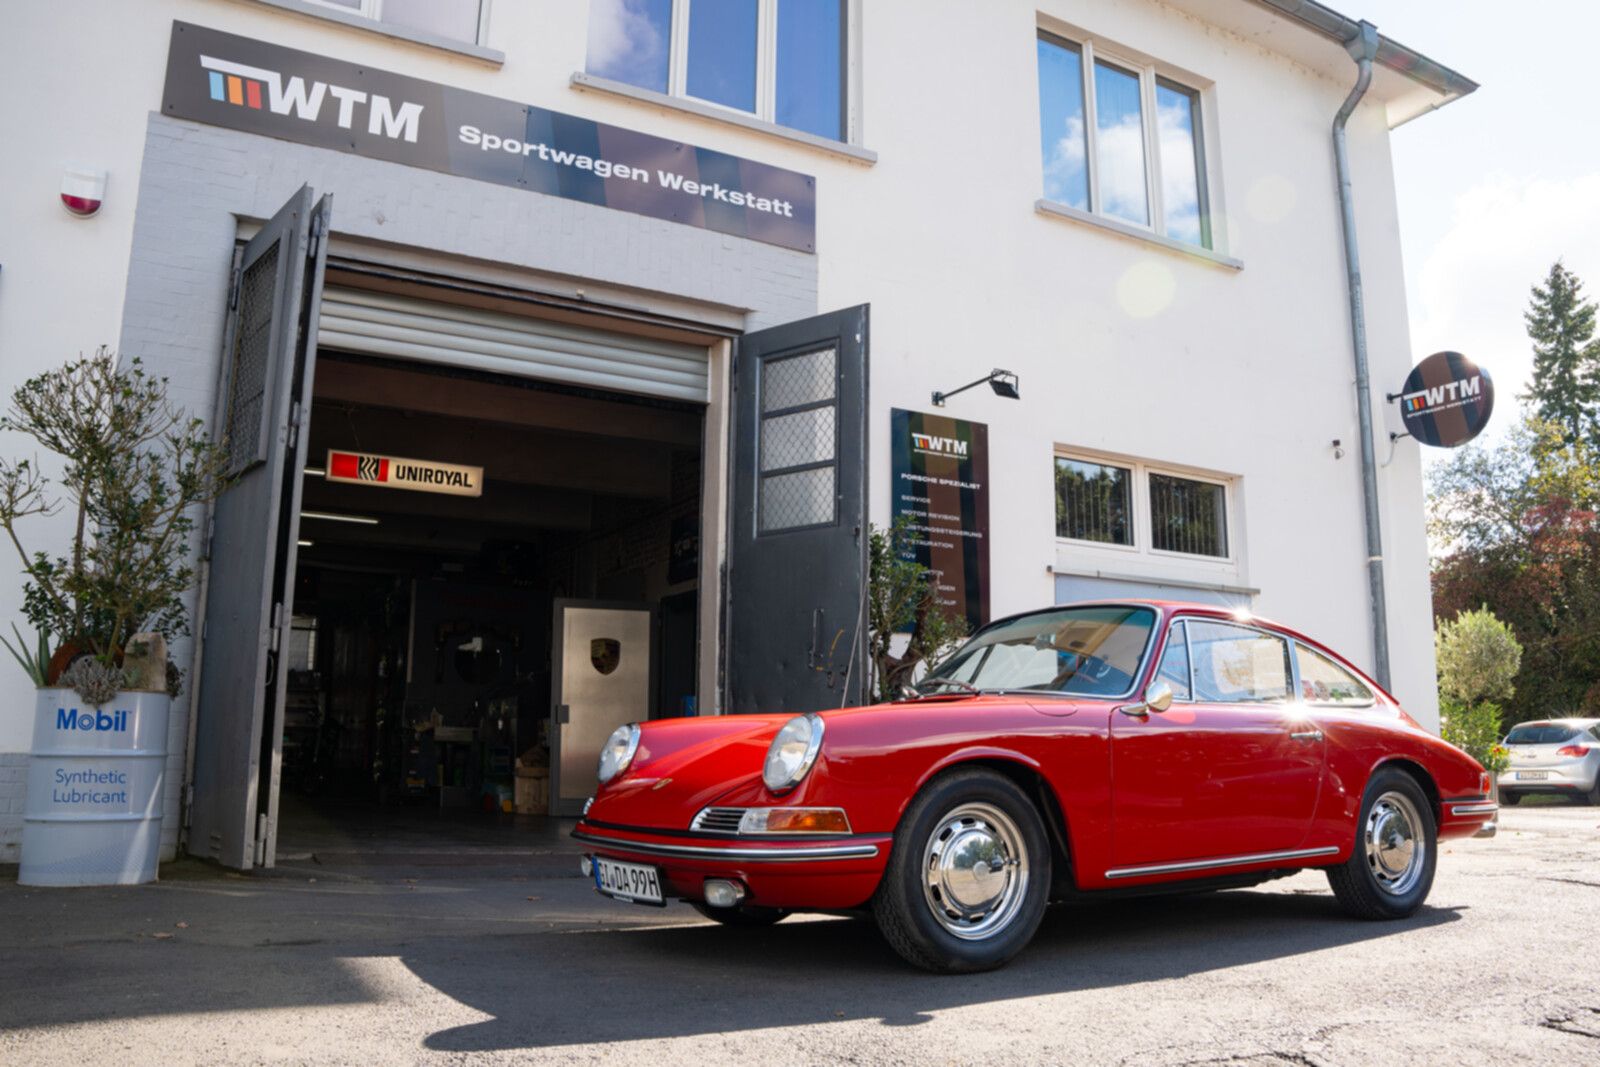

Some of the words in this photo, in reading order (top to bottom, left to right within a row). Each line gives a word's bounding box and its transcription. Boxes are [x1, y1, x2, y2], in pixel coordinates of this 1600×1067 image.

[256, 69, 424, 143] WTM
[458, 124, 650, 184] Sportwagen
[657, 169, 793, 219] Werkstatt
[1421, 375, 1480, 407] WTM
[925, 434, 968, 456] WTM
[395, 464, 473, 488] UNIROYAL
[901, 472, 938, 484] PORSCHE
[901, 495, 931, 504] SERVICE
[901, 508, 927, 518] MOTOR
[56, 707, 128, 732] Mobil
[55, 767, 128, 787] Synthetic
[52, 788, 128, 804] Lubricant
